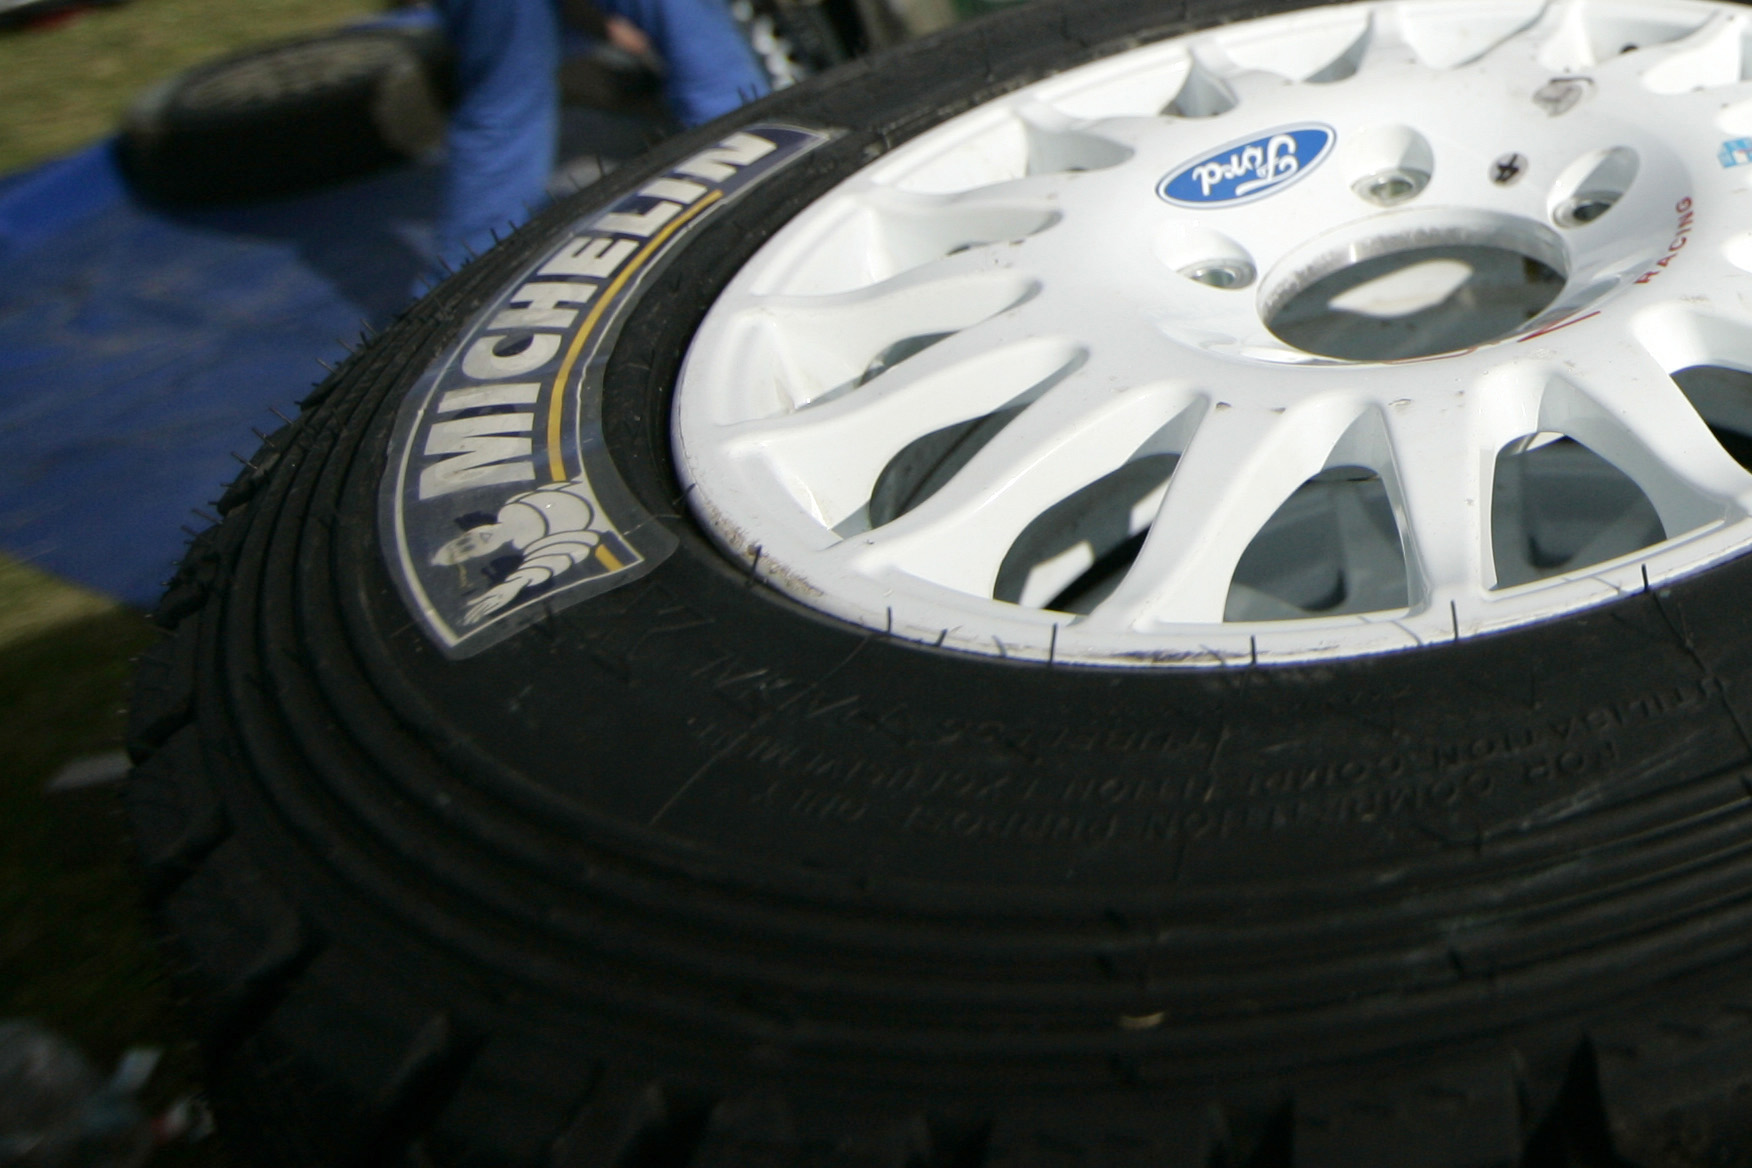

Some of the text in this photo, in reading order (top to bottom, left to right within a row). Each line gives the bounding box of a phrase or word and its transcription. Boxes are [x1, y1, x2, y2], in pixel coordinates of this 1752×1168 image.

[1192, 133, 1301, 197] Ford
[1632, 195, 1694, 284] RACING
[419, 131, 779, 501] MICHELIN
